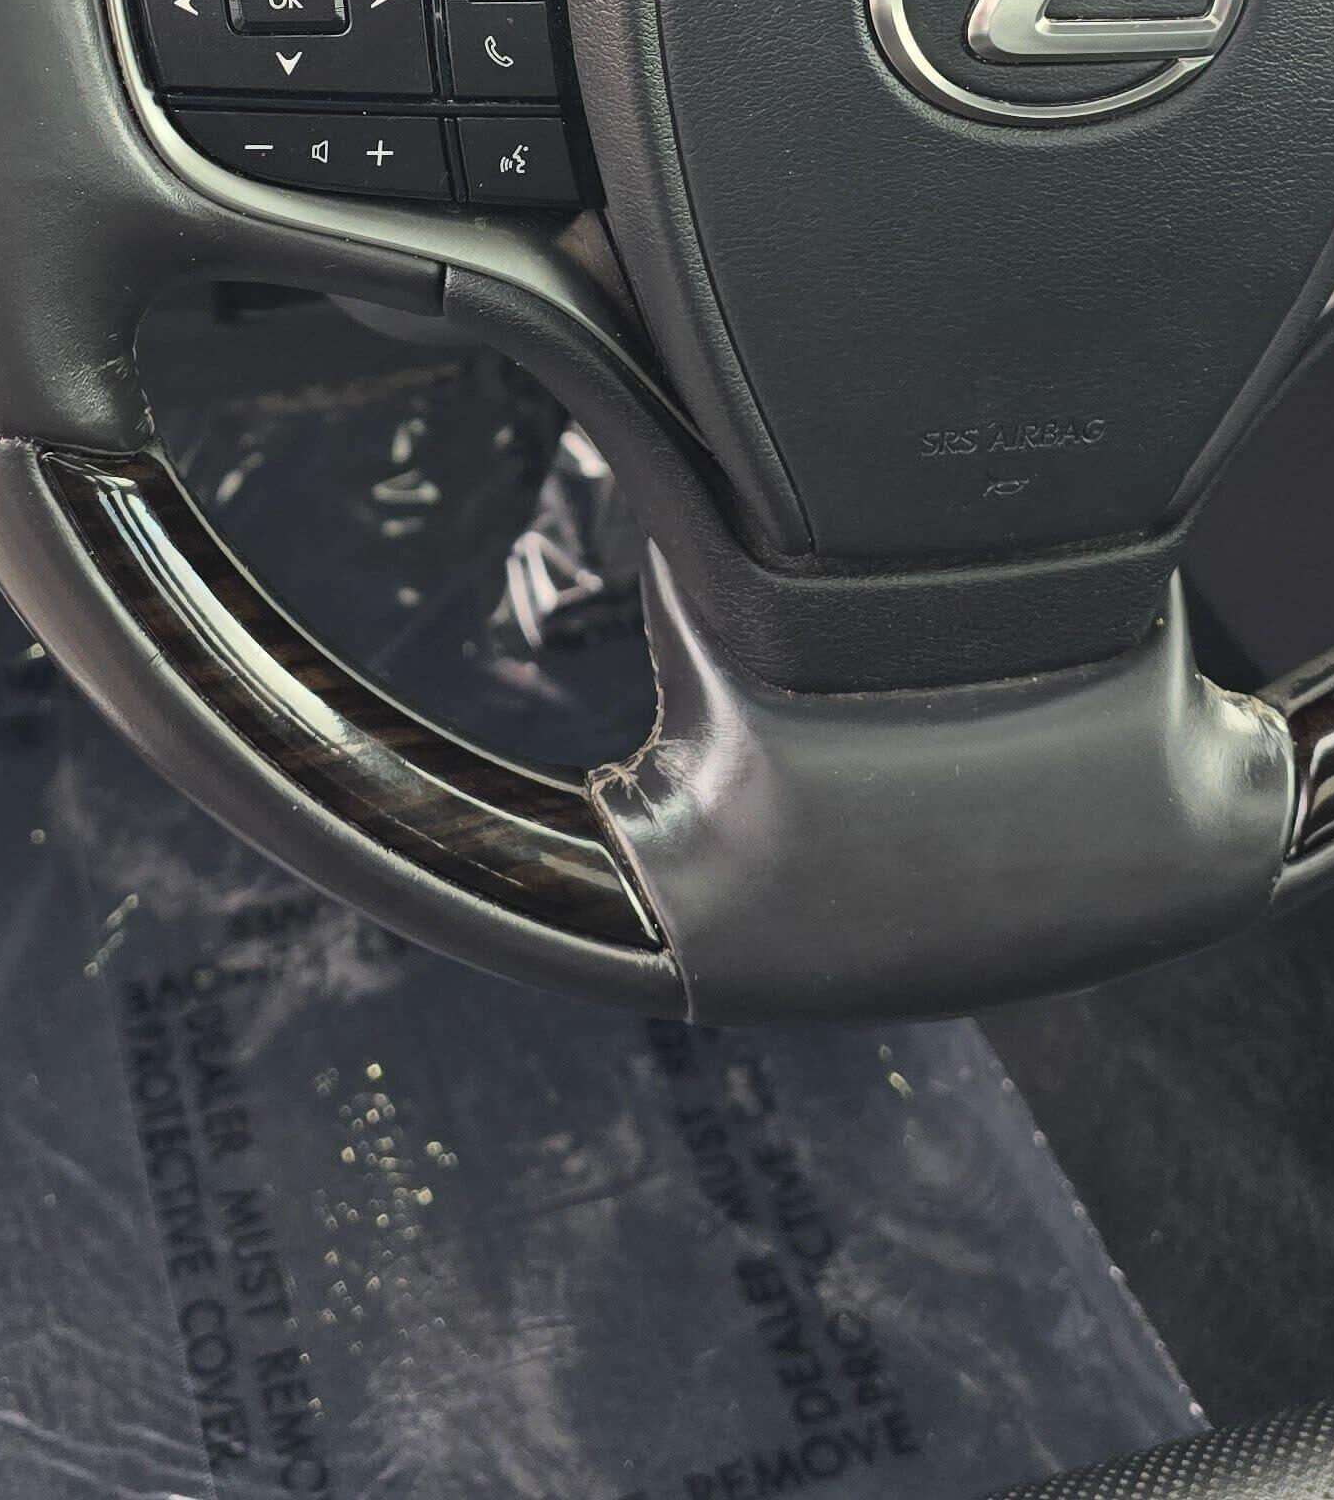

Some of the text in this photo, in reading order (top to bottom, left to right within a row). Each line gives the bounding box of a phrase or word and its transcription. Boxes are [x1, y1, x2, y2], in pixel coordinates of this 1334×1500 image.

[920, 418, 1105, 457] SRS AIRBAG
[671, 1102, 757, 1226] MUST
[214, 1187, 295, 1321] MUST
[749, 1142, 887, 1409] PROCTIVE
[178, 1297, 255, 1472] COVER
[730, 1255, 842, 1428] DEALER
